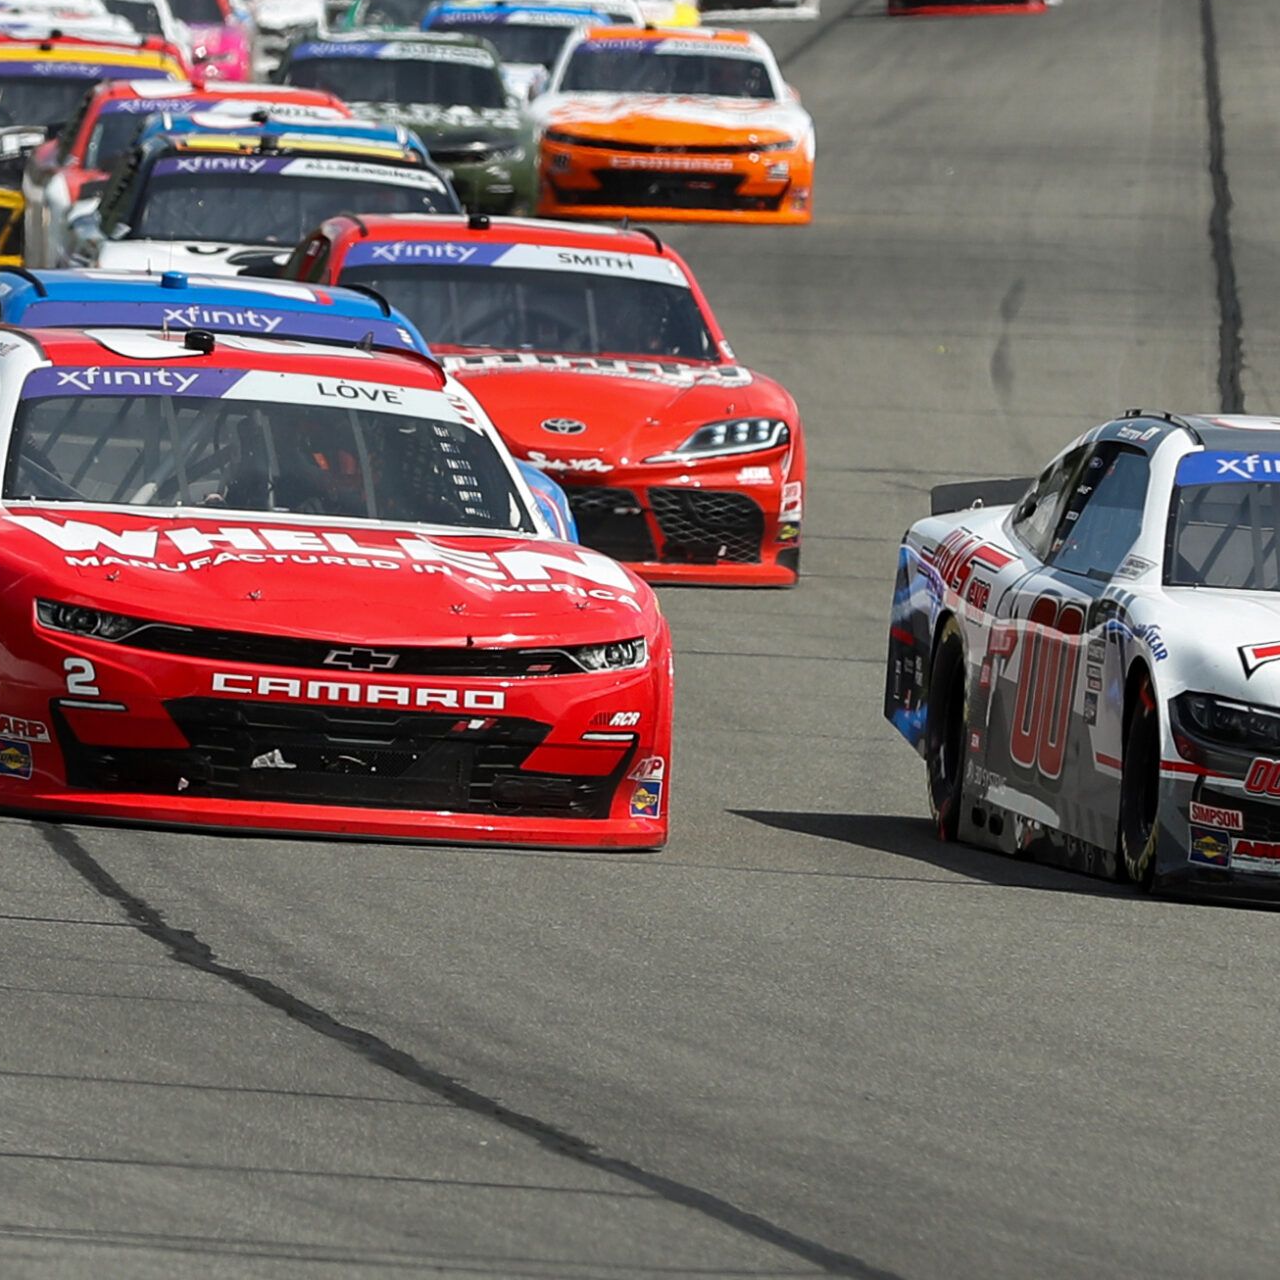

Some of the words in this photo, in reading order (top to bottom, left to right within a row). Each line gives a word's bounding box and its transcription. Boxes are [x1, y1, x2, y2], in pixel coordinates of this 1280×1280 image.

[176, 156, 267, 175] xfinity
[372, 241, 479, 262] xfinity
[558, 252, 634, 270] SMITH
[163, 305, 284, 333] xfinity
[57, 368, 199, 393] xfinity
[316, 381, 404, 405] LOVE
[2, 516, 637, 594] WHELEN
[64, 552, 400, 573] MANUFACTURED
[411, 563, 453, 576] IN
[465, 576, 642, 613] AMERICA
[63, 656, 100, 696] 2
[212, 673, 505, 709] CAMARO
[1010, 595, 1085, 780] 00
[608, 711, 641, 727] RCR
[1191, 803, 1240, 828] SIMPSON
